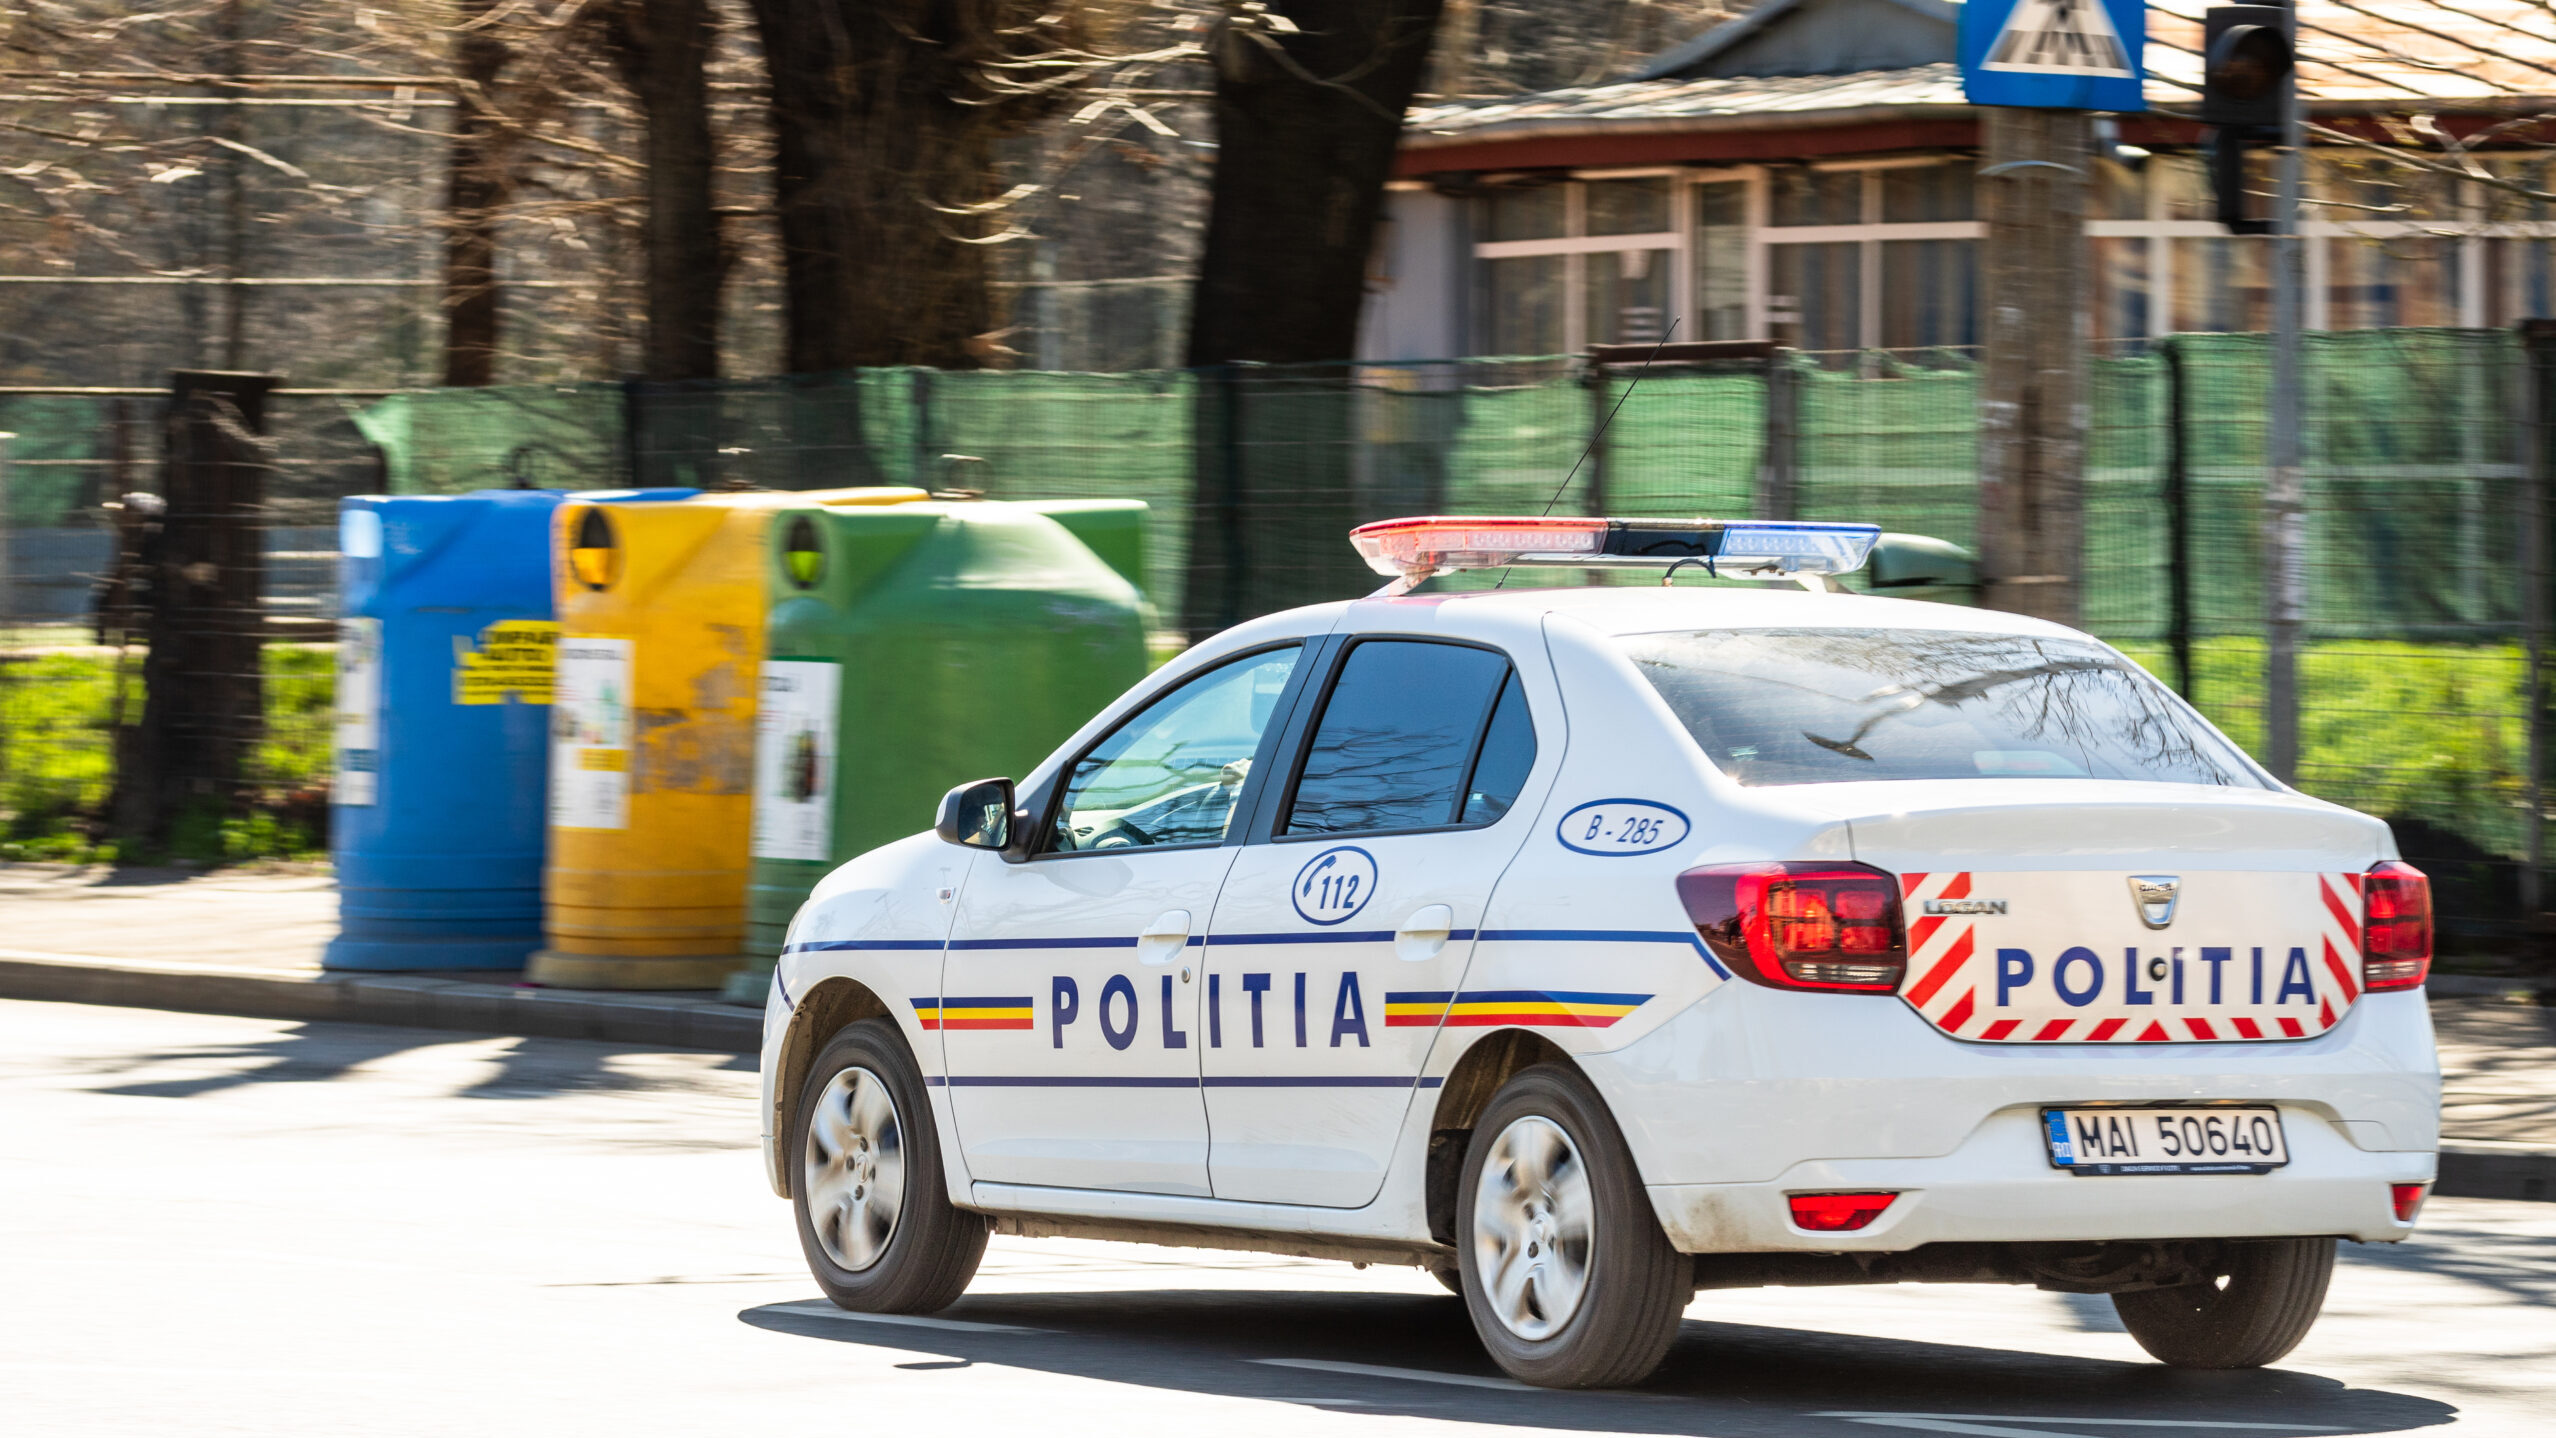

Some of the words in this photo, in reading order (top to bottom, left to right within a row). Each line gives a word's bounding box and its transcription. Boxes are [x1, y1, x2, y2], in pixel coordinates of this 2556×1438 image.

[1319, 874, 1360, 910] 112
[1923, 900, 2008, 916] LOGAN
[1994, 945, 2318, 1008] POLITIA
[1051, 971, 1371, 1051] POLITIA
[2074, 1115, 2140, 1158] MAI
[2154, 1115, 2275, 1157] 50640
